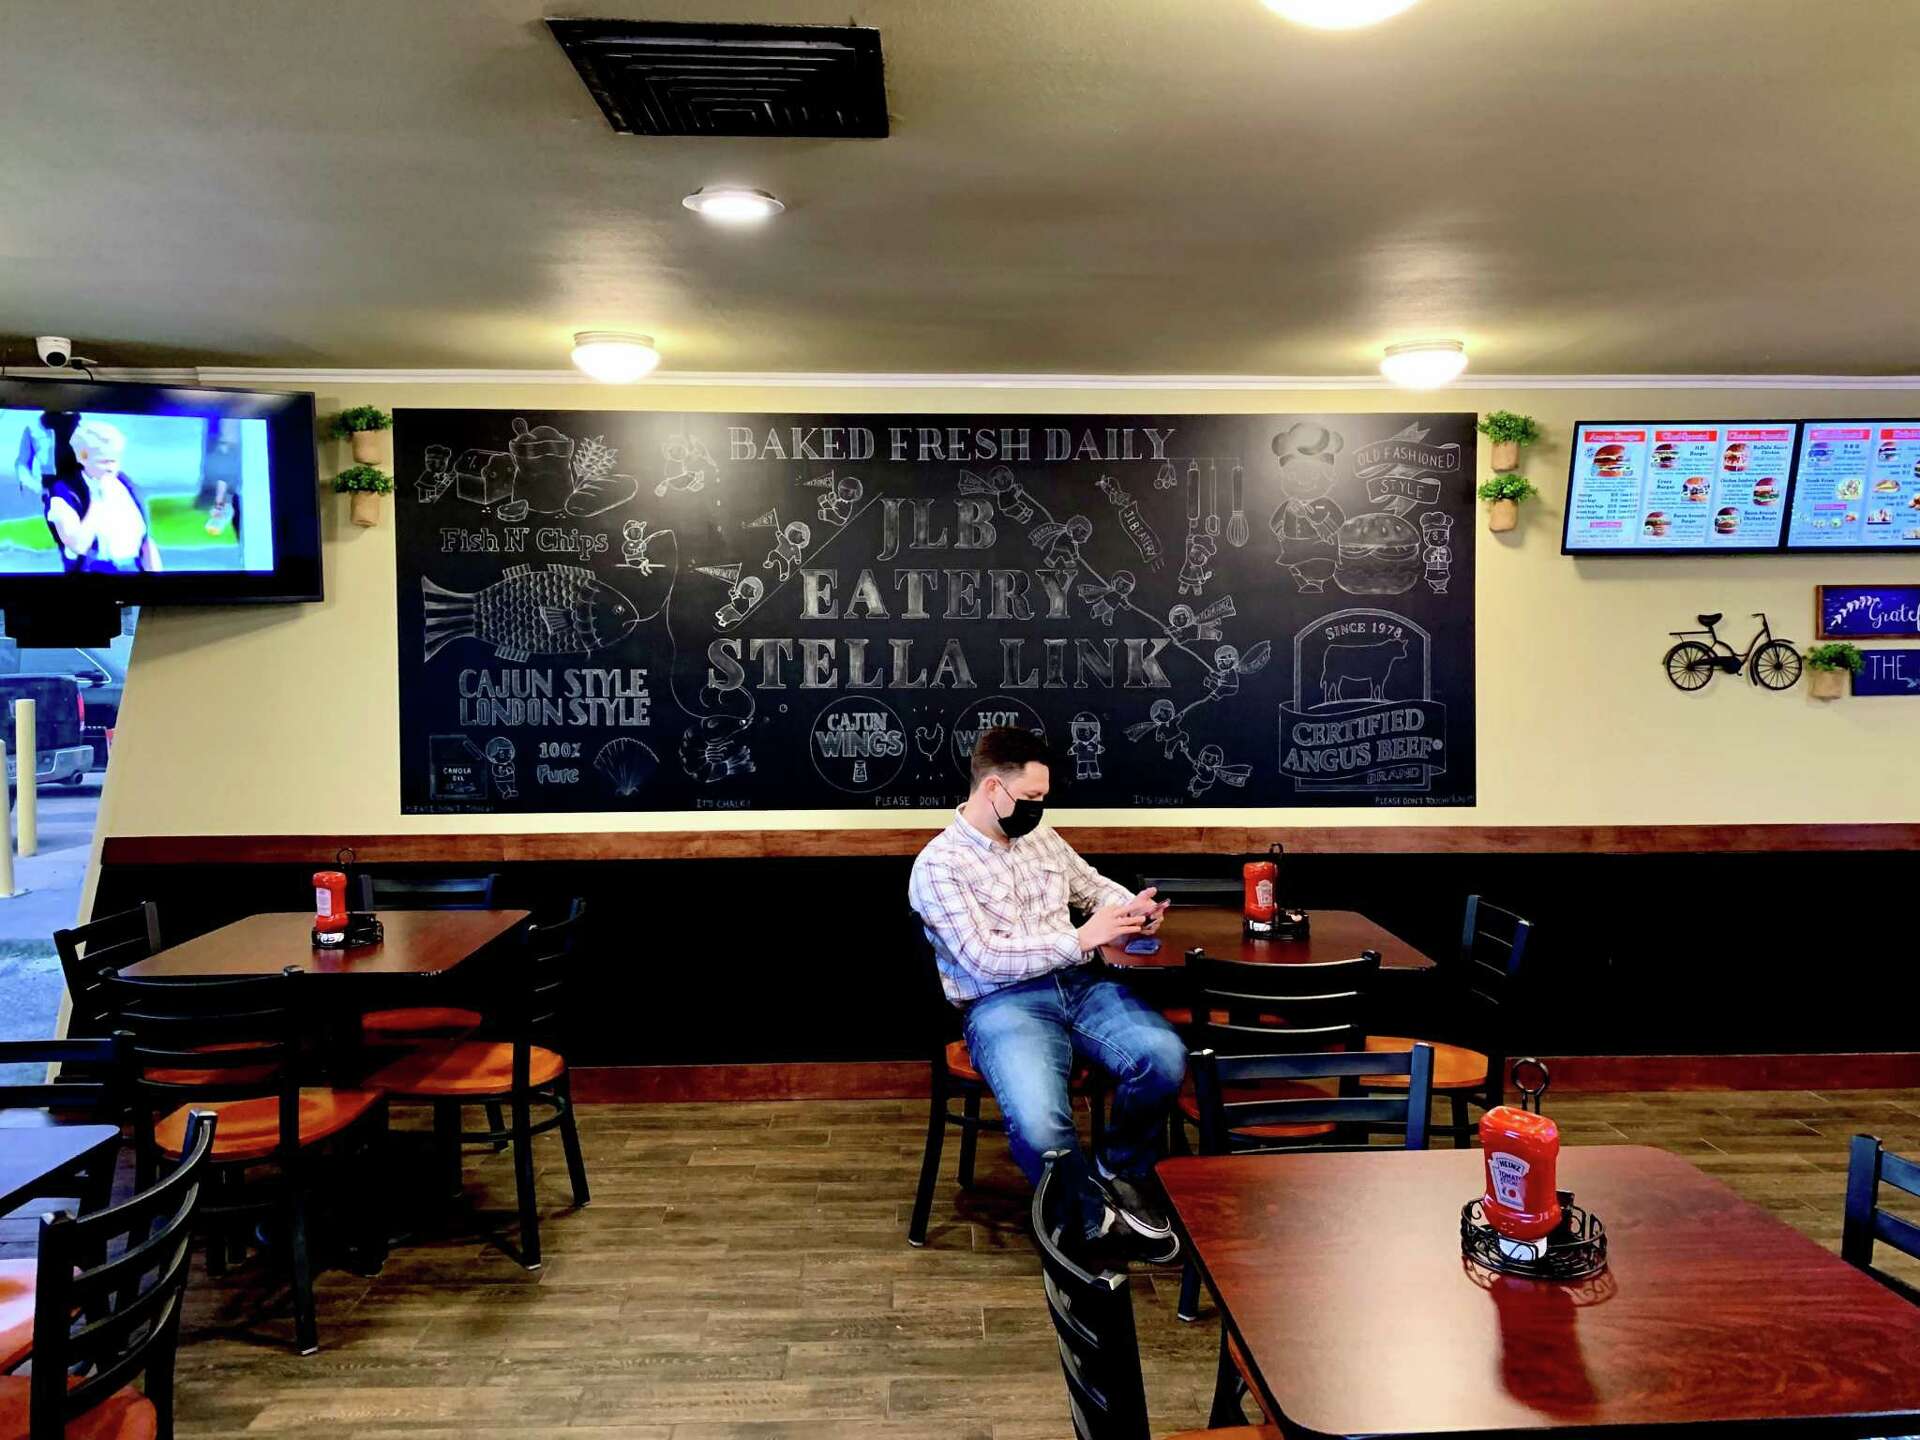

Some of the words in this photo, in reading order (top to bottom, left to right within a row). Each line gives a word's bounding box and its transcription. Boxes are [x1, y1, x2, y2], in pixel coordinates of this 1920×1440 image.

[728, 427, 874, 460] BAKED
[888, 427, 1031, 461] FRESH
[1044, 428, 1175, 461] DAILY
[1357, 450, 1381, 467] OLD
[1384, 446, 1456, 469] FASHIONED
[1379, 479, 1425, 500] STYLE
[876, 498, 998, 561] JLB
[440, 527, 499, 552] Fish
[536, 528, 609, 560] Chips
[800, 568, 1078, 620] EATERY
[1325, 622, 1367, 641] SINCE
[708, 638, 977, 691] STELLA
[1000, 638, 1171, 689] LINK
[1870, 655, 1907, 680] THE
[458, 668, 552, 698] CAJUN
[564, 668, 649, 698] STYLE
[459, 698, 563, 726] LONDON
[567, 697, 651, 726] STYLE
[827, 712, 888, 731] CAJUN
[977, 711, 1019, 730] HOT
[1292, 708, 1425, 747] CERTIFIED
[538, 742, 581, 759] 100%
[815, 730, 904, 758] WINGS
[1282, 742, 1371, 773] ANGUS
[443, 767, 472, 775] CANOLA
[536, 764, 580, 785] Pure
[1366, 767, 1420, 785] BRAND
[874, 795, 911, 807] PLEASE
[1500, 1160, 1521, 1172] HEINZ
